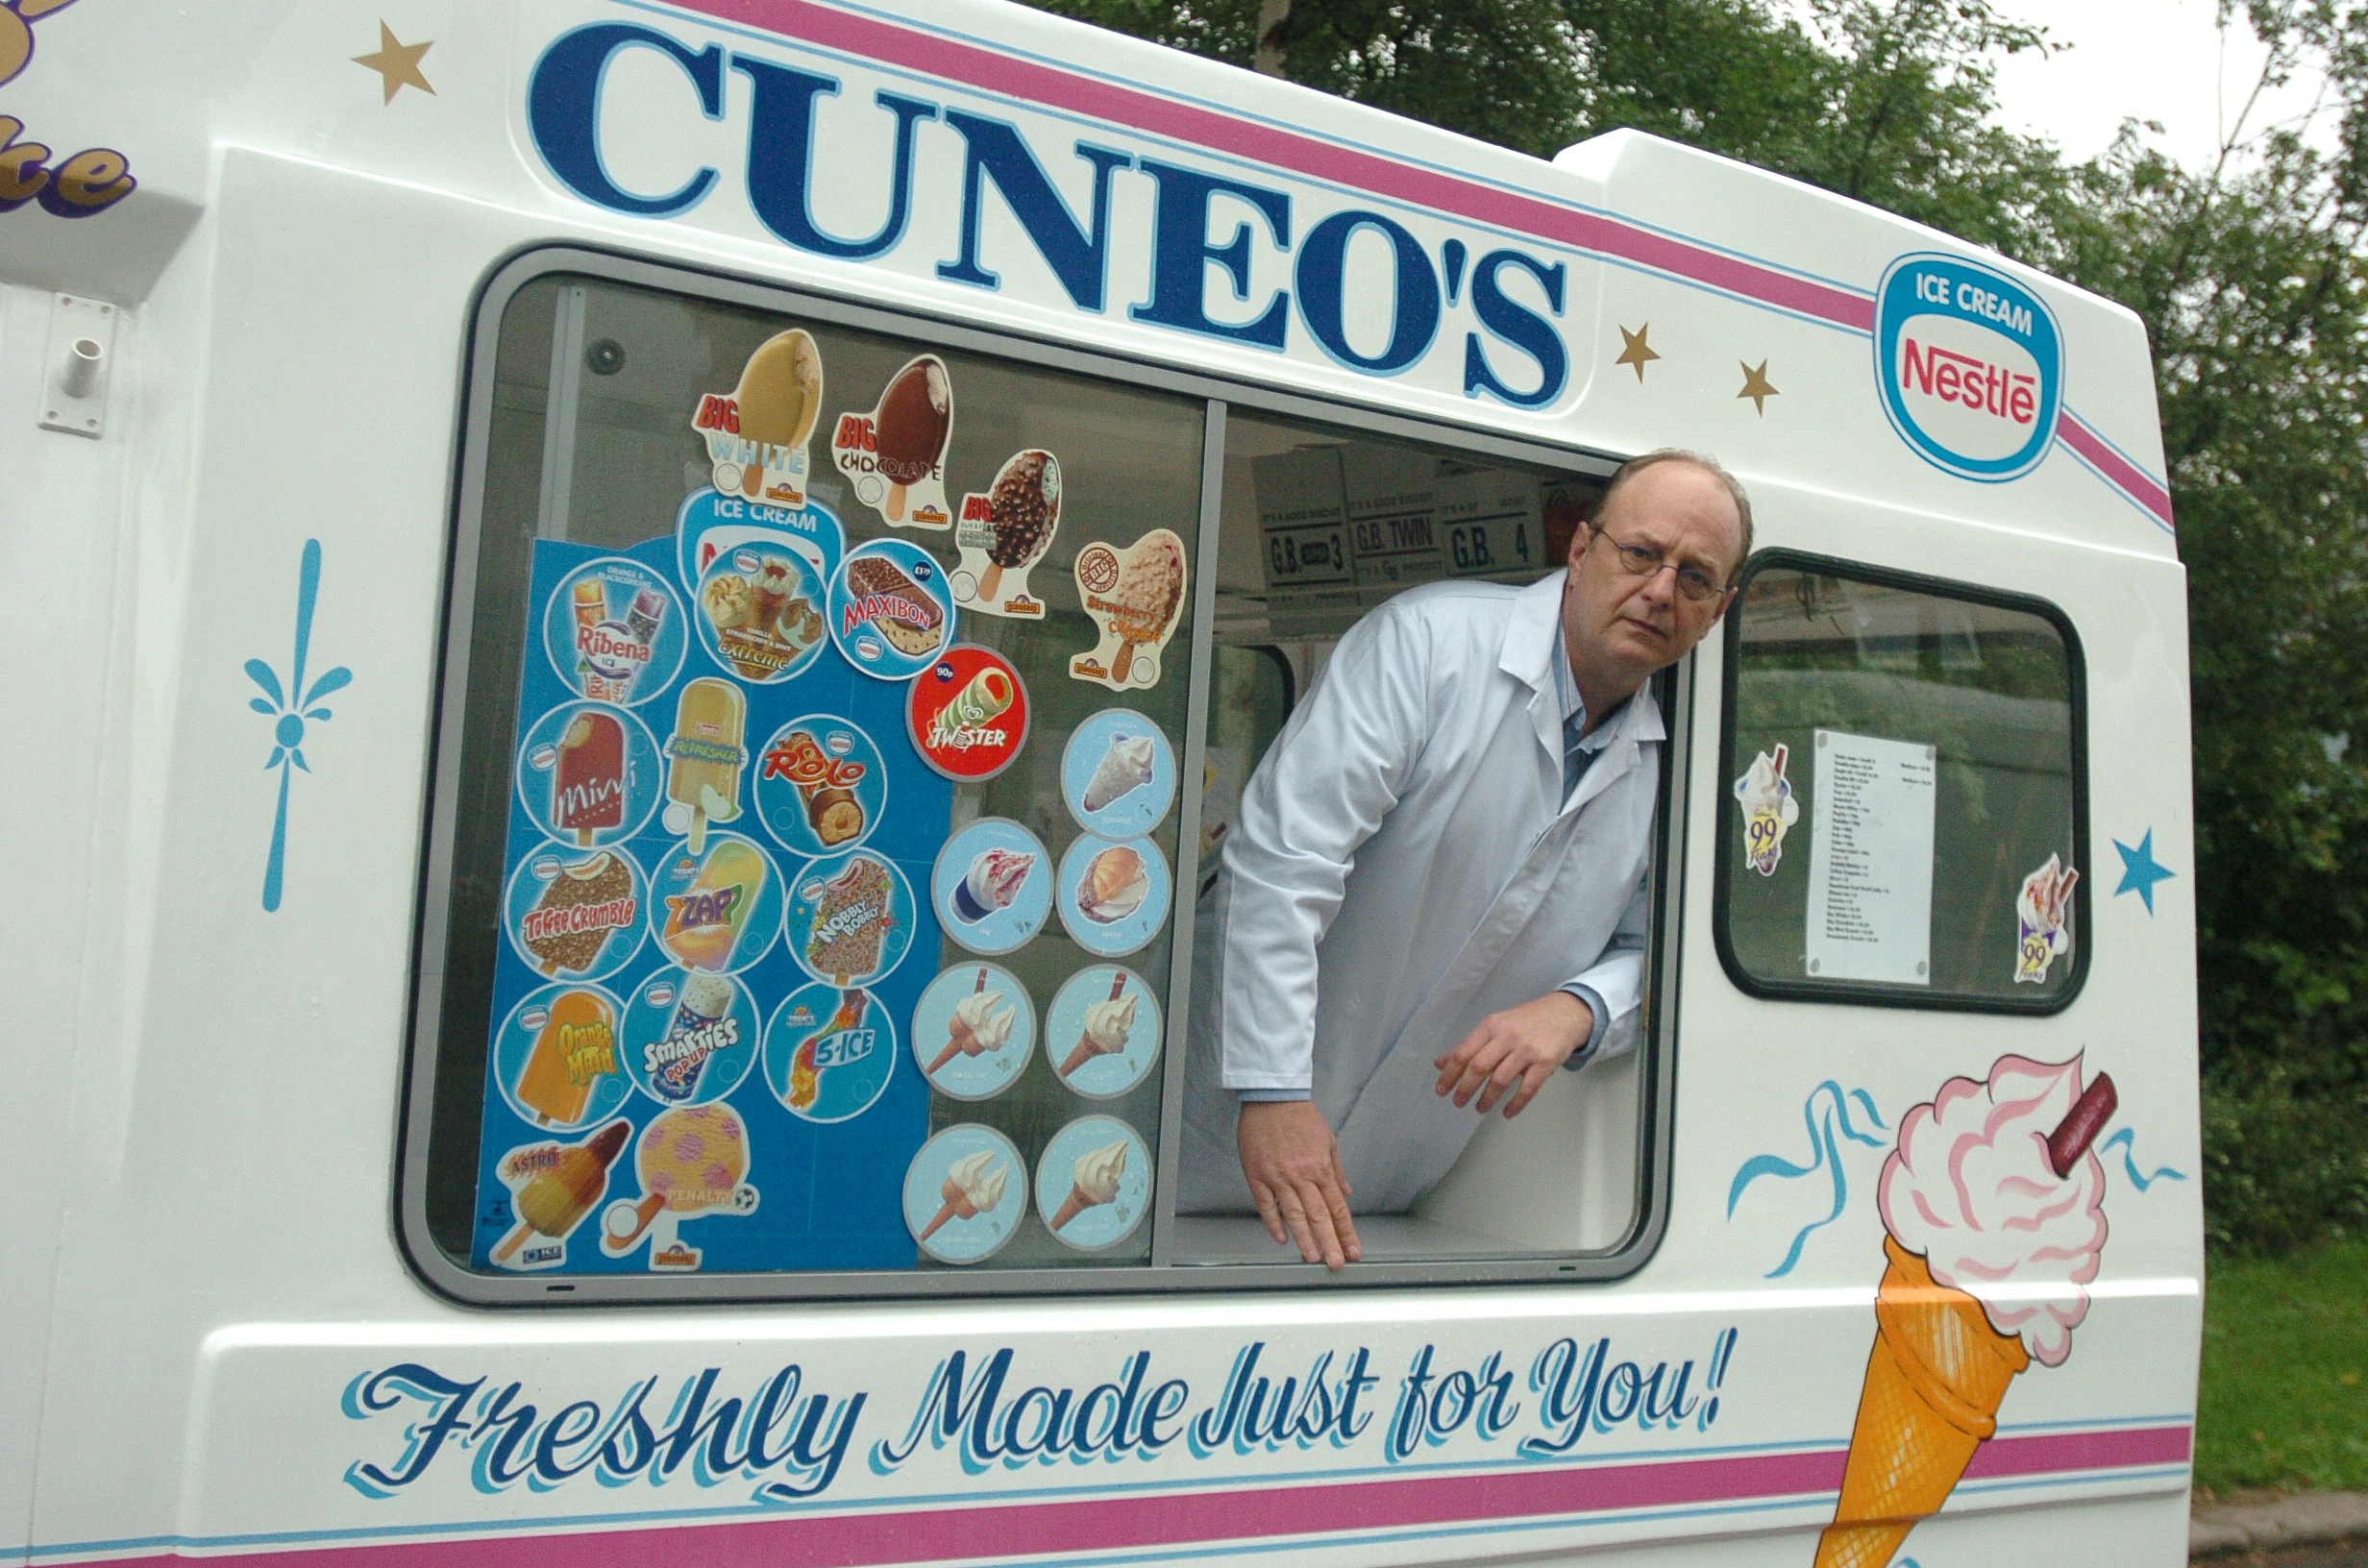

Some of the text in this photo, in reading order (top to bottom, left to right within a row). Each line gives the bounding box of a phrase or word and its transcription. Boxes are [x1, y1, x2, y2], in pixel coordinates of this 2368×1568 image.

[526, 19, 1570, 410] CUNEO'S
[1915, 273, 2033, 336] ICE CREAM
[697, 395, 740, 434] BIG
[835, 415, 877, 453] BIG
[709, 433, 805, 475] WHITE
[841, 452, 942, 481] CHOCOLATE
[713, 499, 817, 532] ICE CREAM
[963, 496, 993, 523] BIG
[1387, 517, 1434, 548] TWIN
[1516, 523, 1529, 563] 4
[1330, 533, 1344, 571] 3
[843, 595, 930, 638] MAXIBON
[1087, 595, 1155, 622] Strawberry
[577, 625, 651, 662] Ribena
[717, 637, 789, 671] Extreme
[936, 667, 953, 678] 90p
[930, 723, 1006, 752] TWISTER
[763, 750, 866, 790] Rolo
[1750, 819, 1777, 849] 99
[679, 888, 734, 931] ZAP
[816, 900, 867, 943] NOBBLY
[842, 906, 879, 937] BOBBLY
[2024, 943, 2045, 968] 99
[556, 1022, 613, 1058] Orange
[566, 1045, 617, 1086] Maid
[665, 1046, 706, 1082] POP UP
[511, 1152, 557, 1175] ASTRO
[668, 1188, 733, 1205] PENALTY
[344, 1327, 1738, 1503] Freshly Made Just for You!
